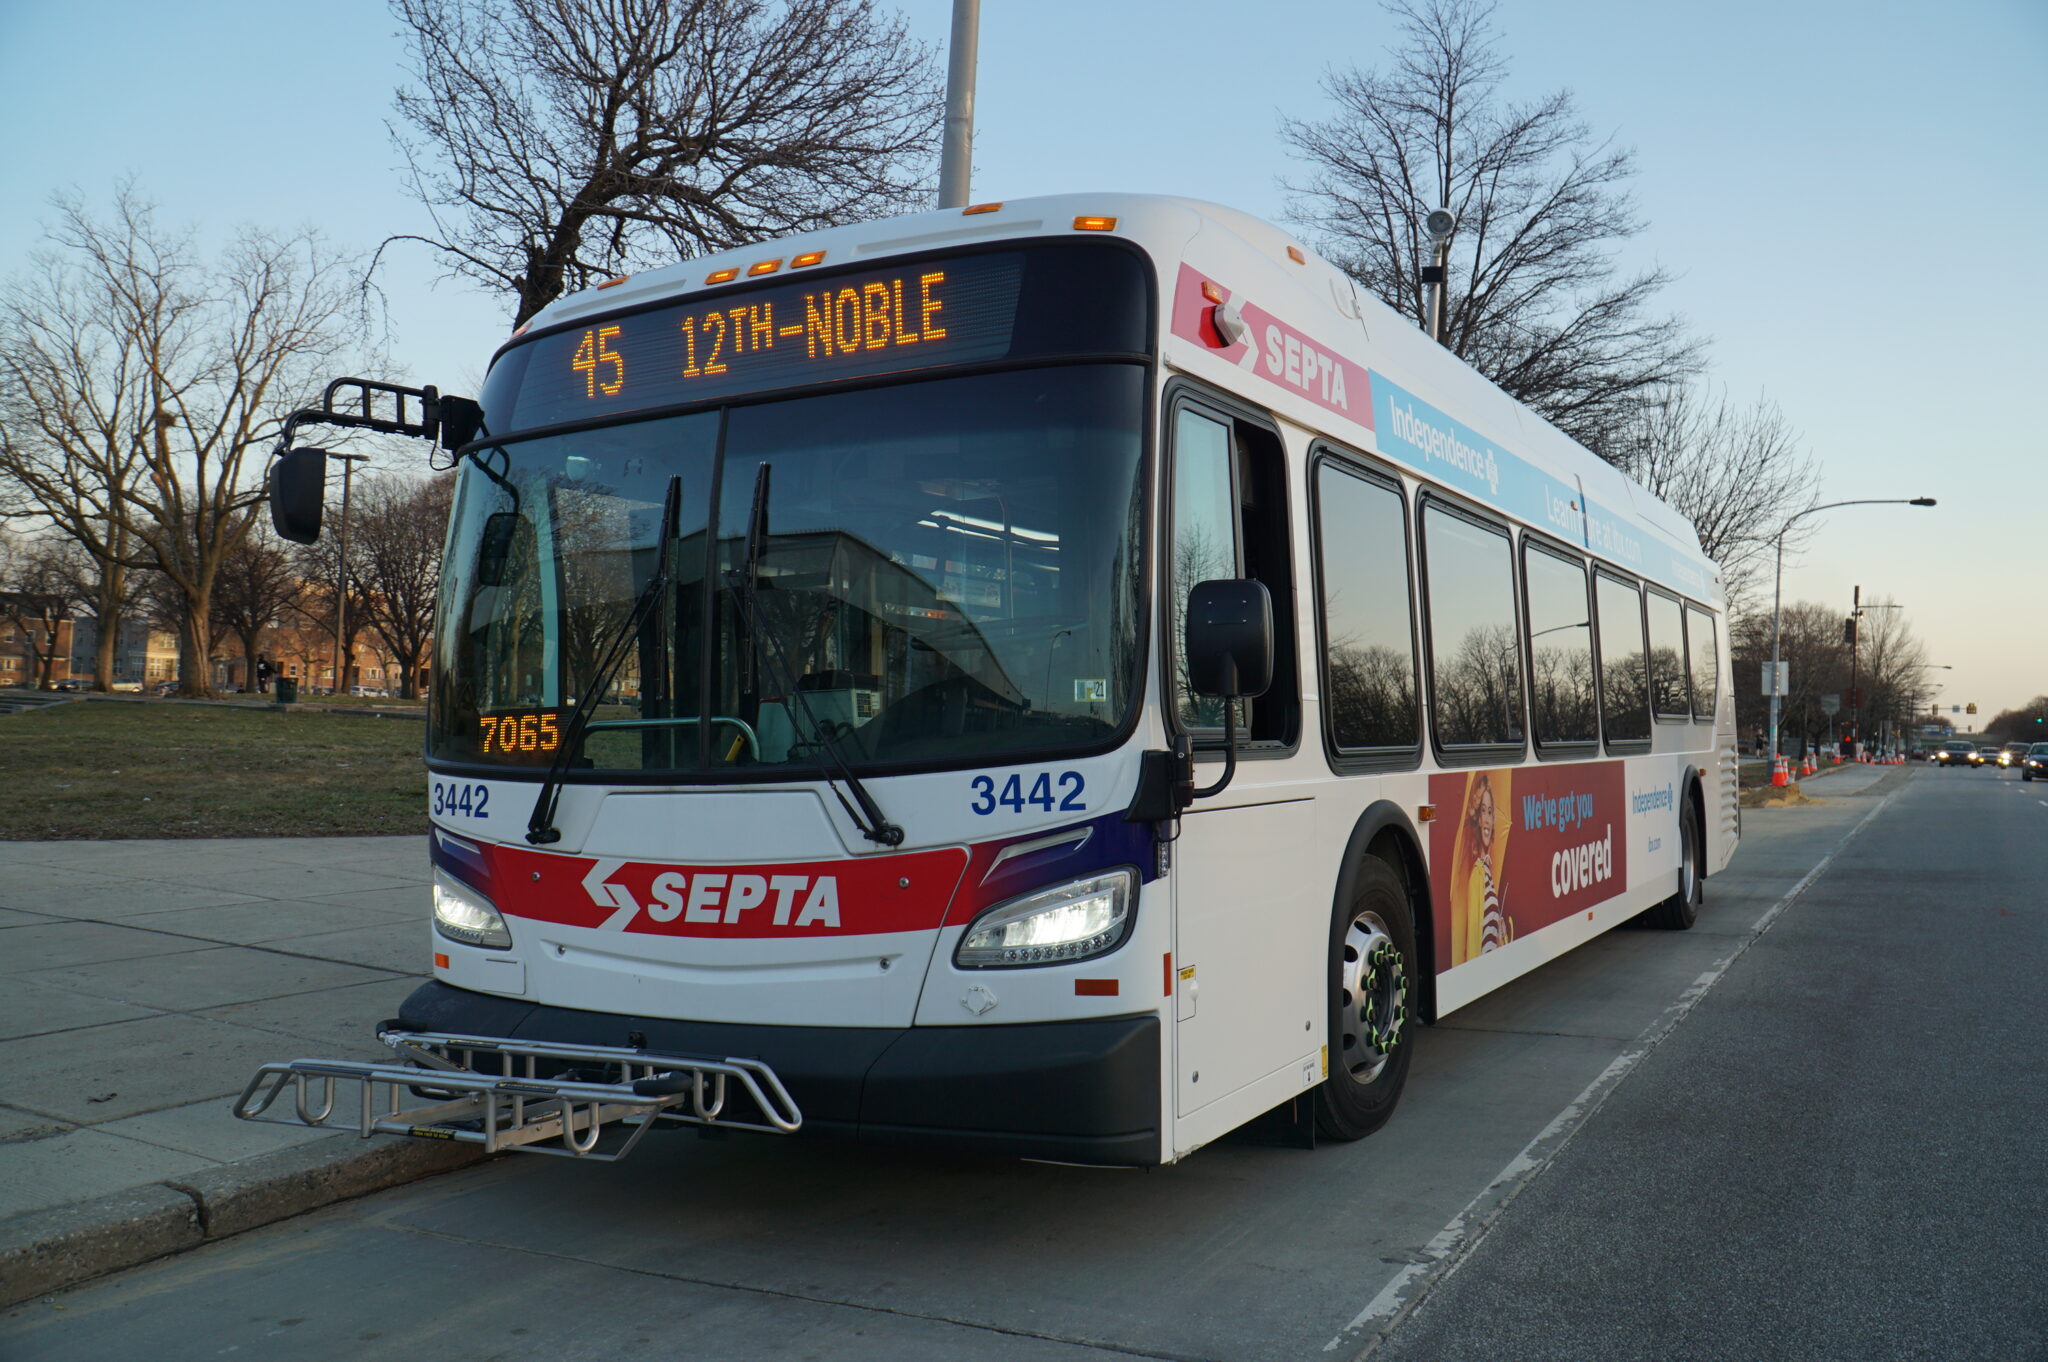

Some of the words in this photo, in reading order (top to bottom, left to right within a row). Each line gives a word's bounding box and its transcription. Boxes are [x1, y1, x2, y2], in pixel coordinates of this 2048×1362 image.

[573, 325, 623, 398] 45
[681, 271, 946, 378] 12TH-NOBLE
[1265, 324, 1348, 410] SEPTA
[1390, 395, 1484, 480] Independence
[480, 713, 559, 752] 7065
[434, 783, 489, 818] 3442
[971, 771, 1087, 816] 3442
[1523, 794, 1556, 831] We've
[1558, 791, 1575, 832] got
[1577, 793, 1593, 829] you
[1552, 824, 1612, 898] covered
[648, 872, 841, 928] SEPTA
